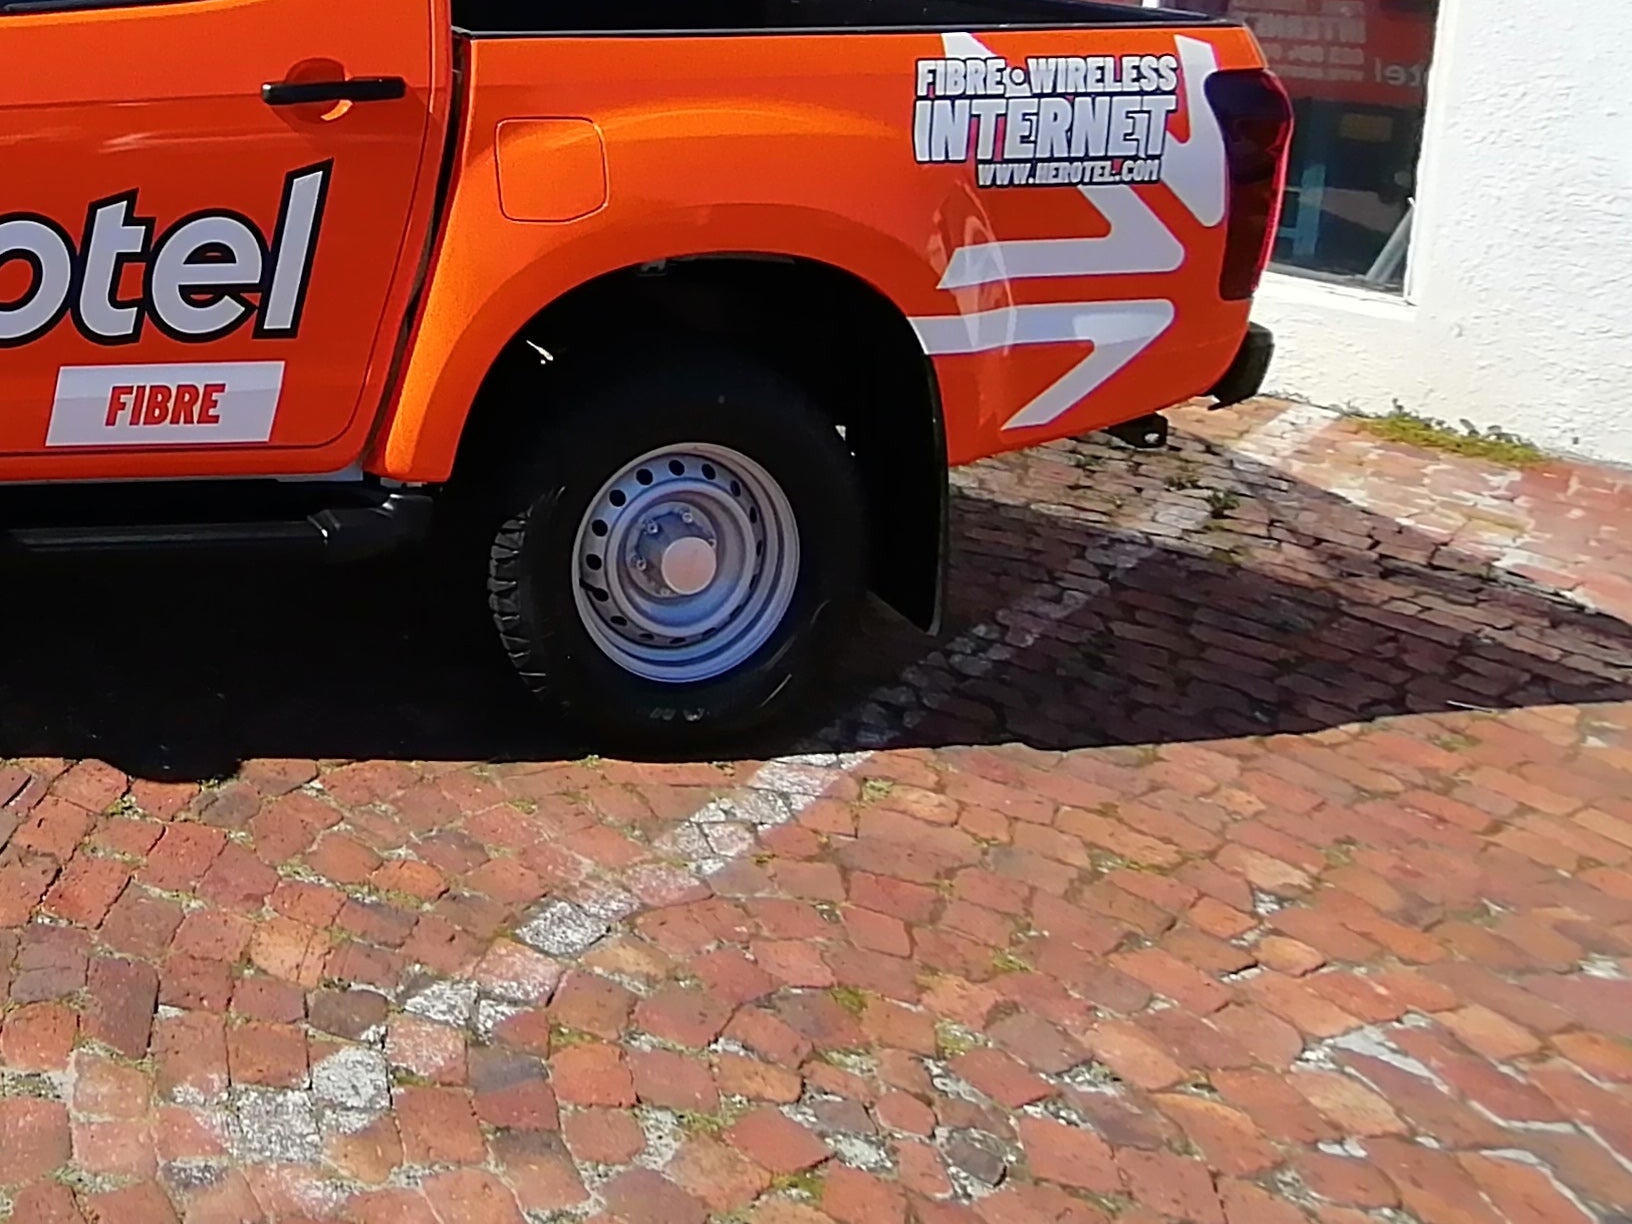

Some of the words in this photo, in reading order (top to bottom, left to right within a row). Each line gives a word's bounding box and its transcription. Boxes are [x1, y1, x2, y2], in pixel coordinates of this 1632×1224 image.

[917, 58, 1006, 96] FIBRE
[1027, 56, 1178, 94] WIRELESS
[915, 95, 1177, 162] INTERNET
[105, 383, 226, 427] FIBRE
